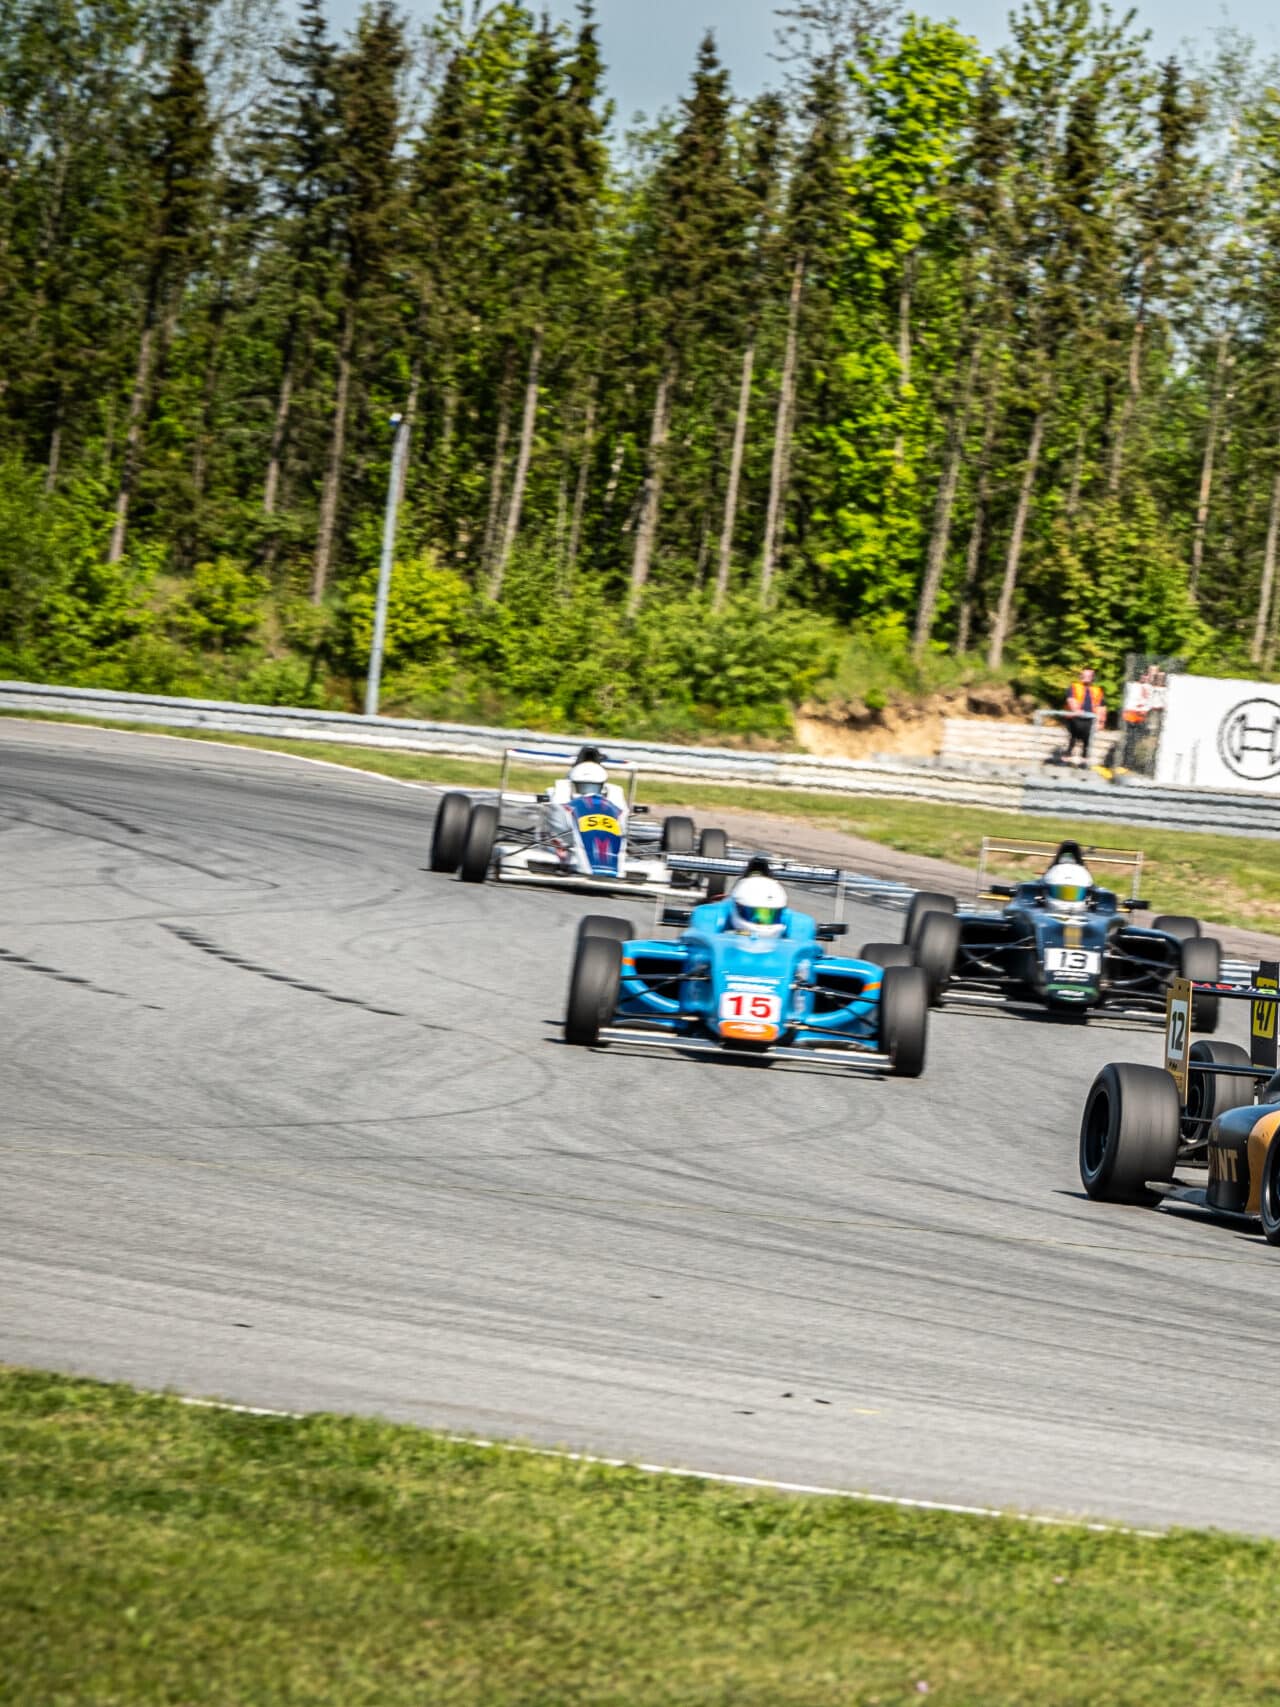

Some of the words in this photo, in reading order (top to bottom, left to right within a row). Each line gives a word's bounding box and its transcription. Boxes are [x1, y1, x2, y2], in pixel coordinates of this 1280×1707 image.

[1060, 951, 1088, 969] 13
[727, 996, 771, 1019] 15
[1171, 1010, 1186, 1052] 12
